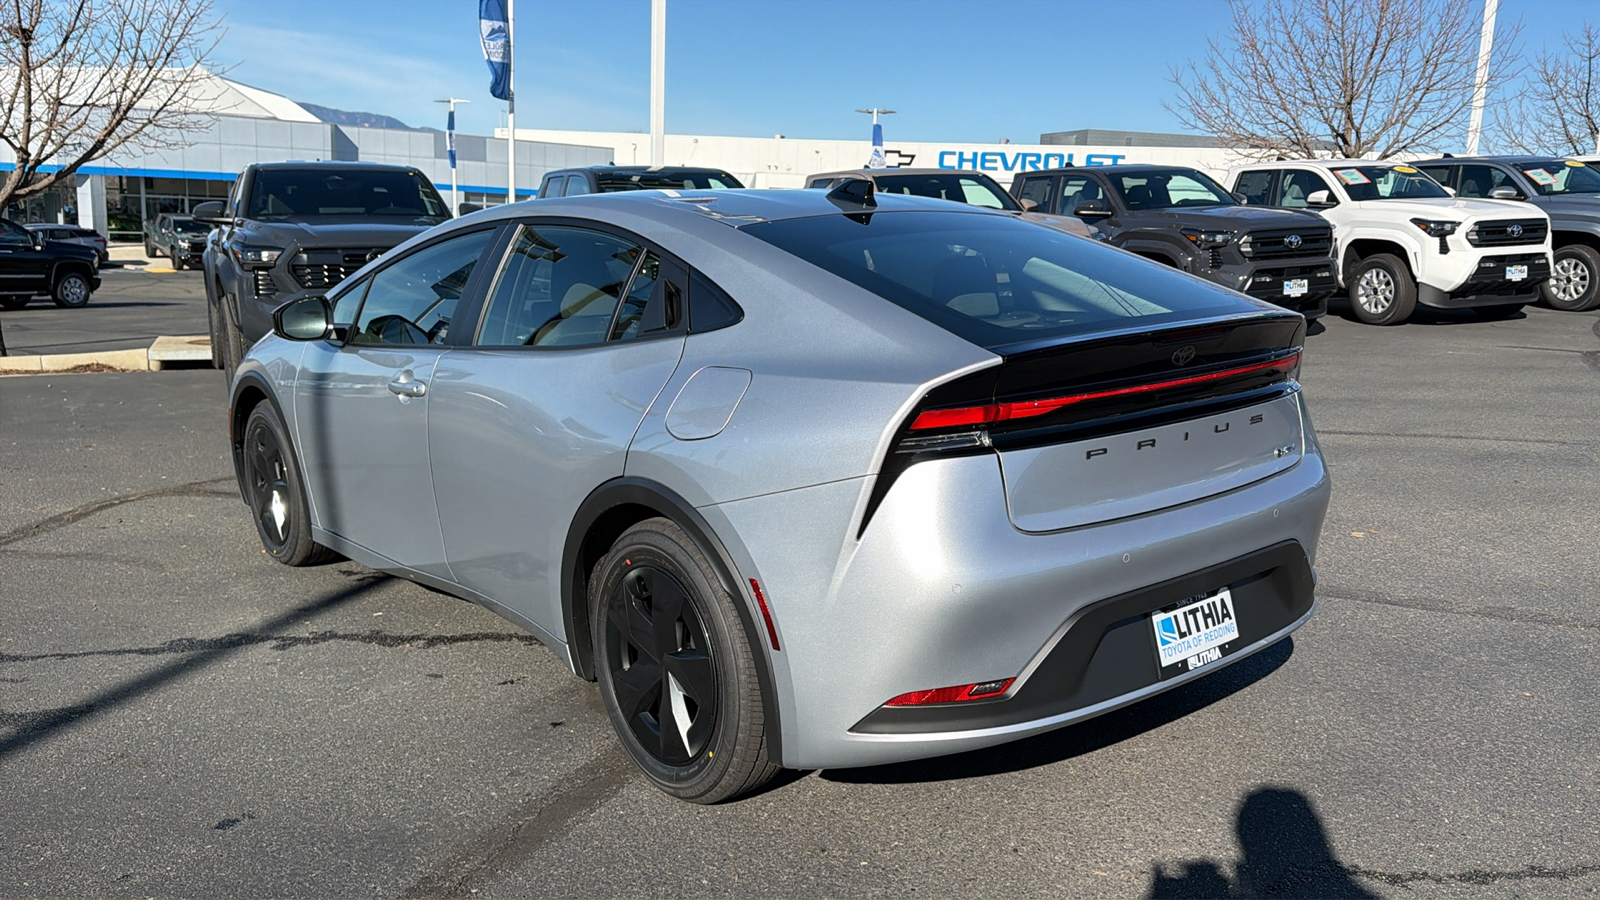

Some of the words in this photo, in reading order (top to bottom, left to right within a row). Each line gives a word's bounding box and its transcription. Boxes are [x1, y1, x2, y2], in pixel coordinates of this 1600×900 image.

[1085, 413, 1263, 460] PRIUS
[1173, 597, 1232, 640] LITHIA
[1176, 598, 1193, 608] SINCE
[1162, 641, 1192, 659] TOYOTA
[1192, 635, 1203, 648] OF
[1204, 622, 1235, 644] REDDING
[1195, 646, 1222, 667] LITHIA
